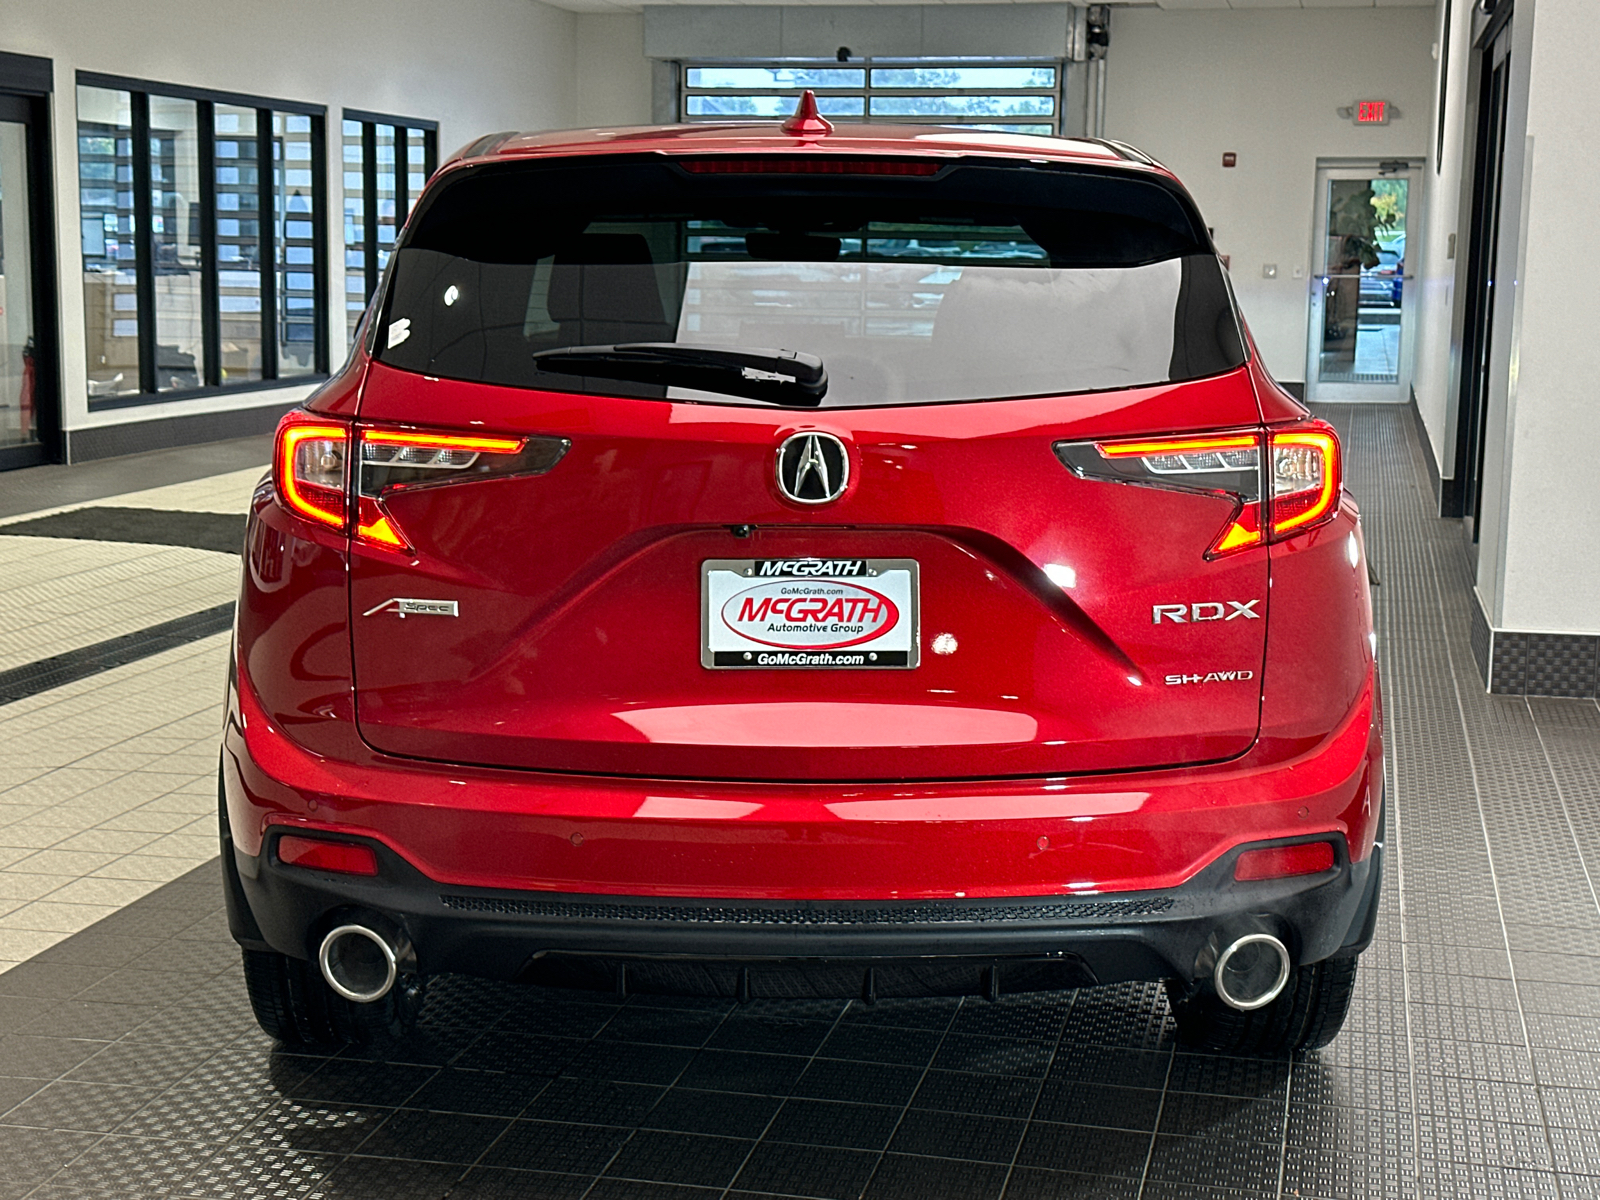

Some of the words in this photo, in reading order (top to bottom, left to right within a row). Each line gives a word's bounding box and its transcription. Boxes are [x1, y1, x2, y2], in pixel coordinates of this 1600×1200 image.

[1358, 102, 1385, 122] EXIT
[780, 587, 844, 595] GoMcGrath.com
[1152, 599, 1261, 625] RDX
[767, 622, 828, 633] Automotive
[830, 623, 864, 634] Group
[757, 653, 864, 665] GoMcGrath.com
